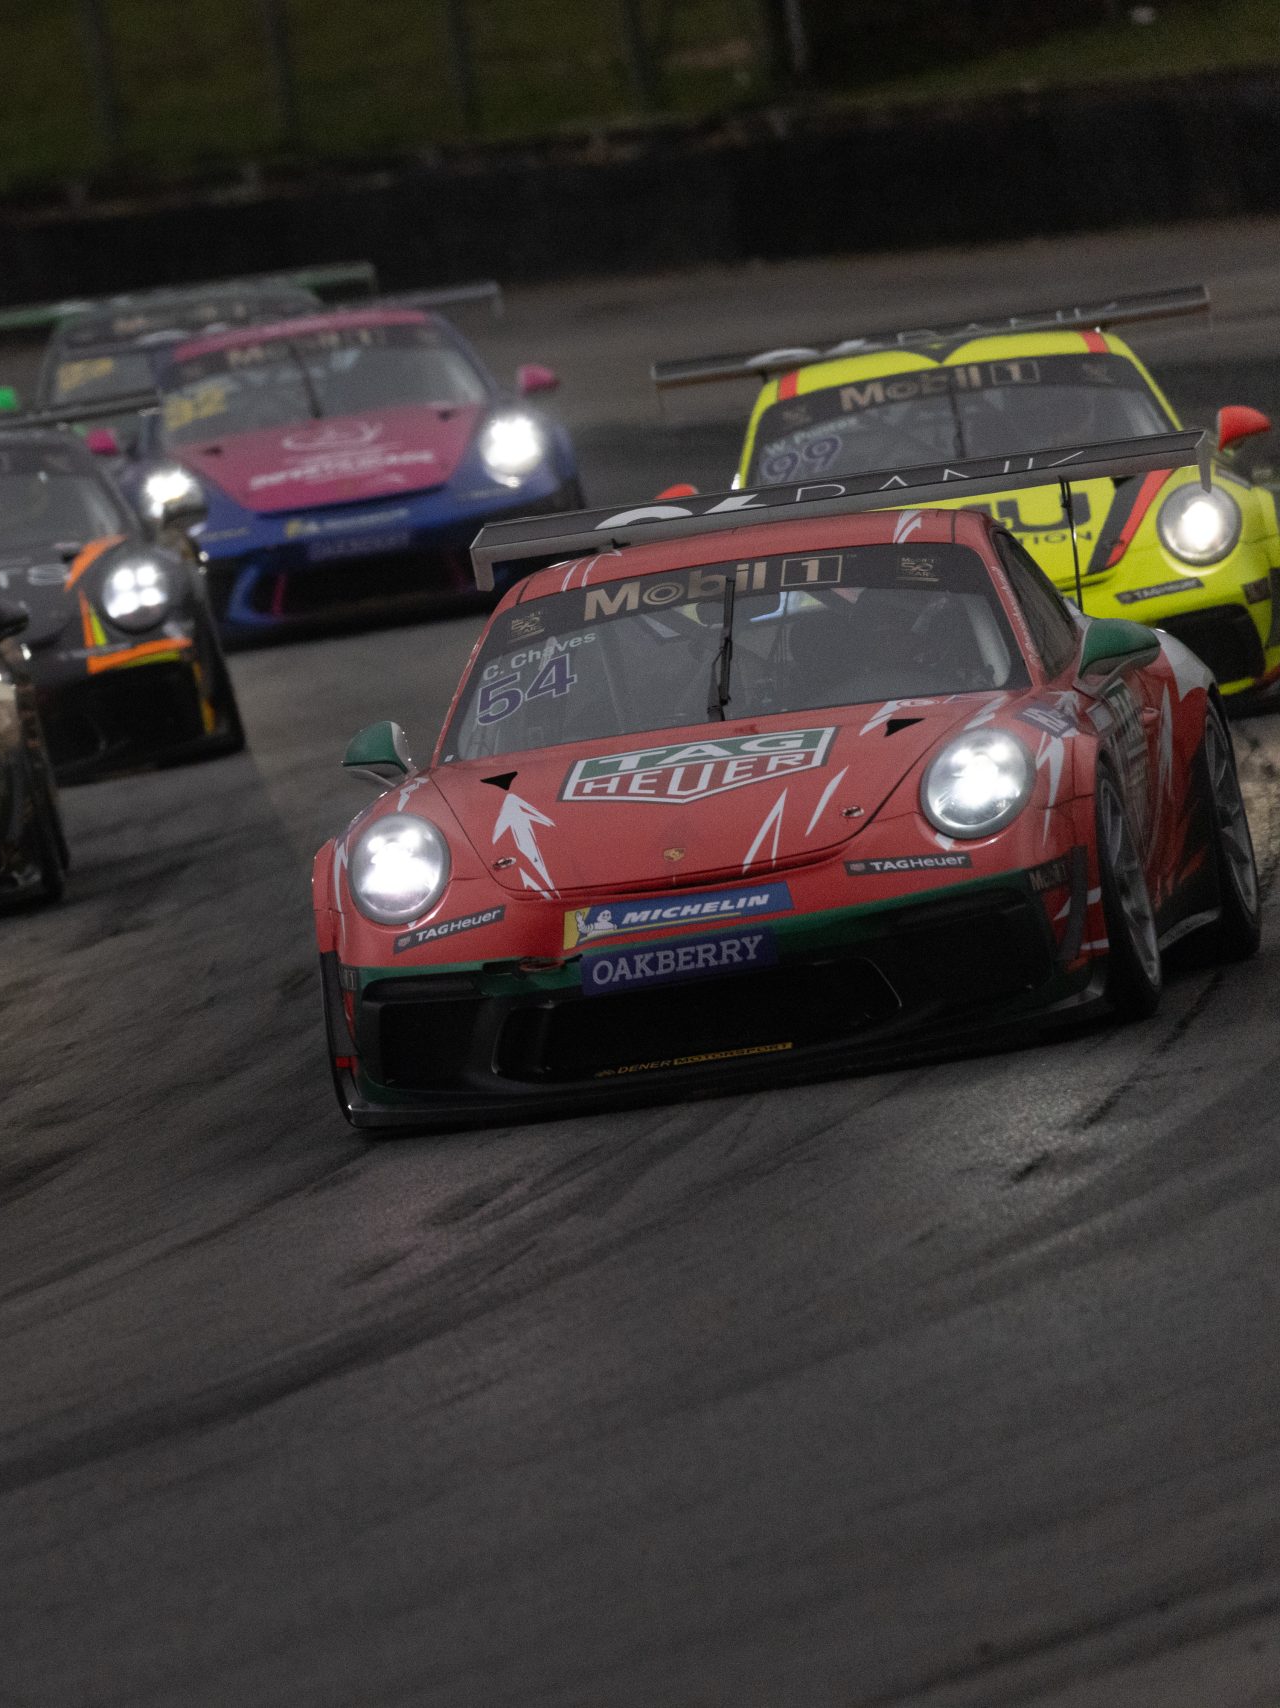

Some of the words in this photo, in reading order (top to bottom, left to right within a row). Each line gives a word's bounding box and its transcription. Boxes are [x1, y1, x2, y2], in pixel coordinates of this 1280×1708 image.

[839, 365, 982, 411] Mobil
[761, 436, 842, 481] 99
[583, 561, 767, 621] Mobil
[483, 664, 505, 681] C.
[510, 632, 597, 669] Chaves
[477, 653, 578, 726] 54
[599, 733, 805, 771] TAG
[582, 753, 806, 796] HEUER
[870, 856, 967, 873] TAGHeuer
[416, 909, 501, 942] TAGHeuer
[622, 894, 769, 925] MICHELIN
[592, 934, 763, 985] OAKBERRY
[617, 1059, 672, 1075] DENER
